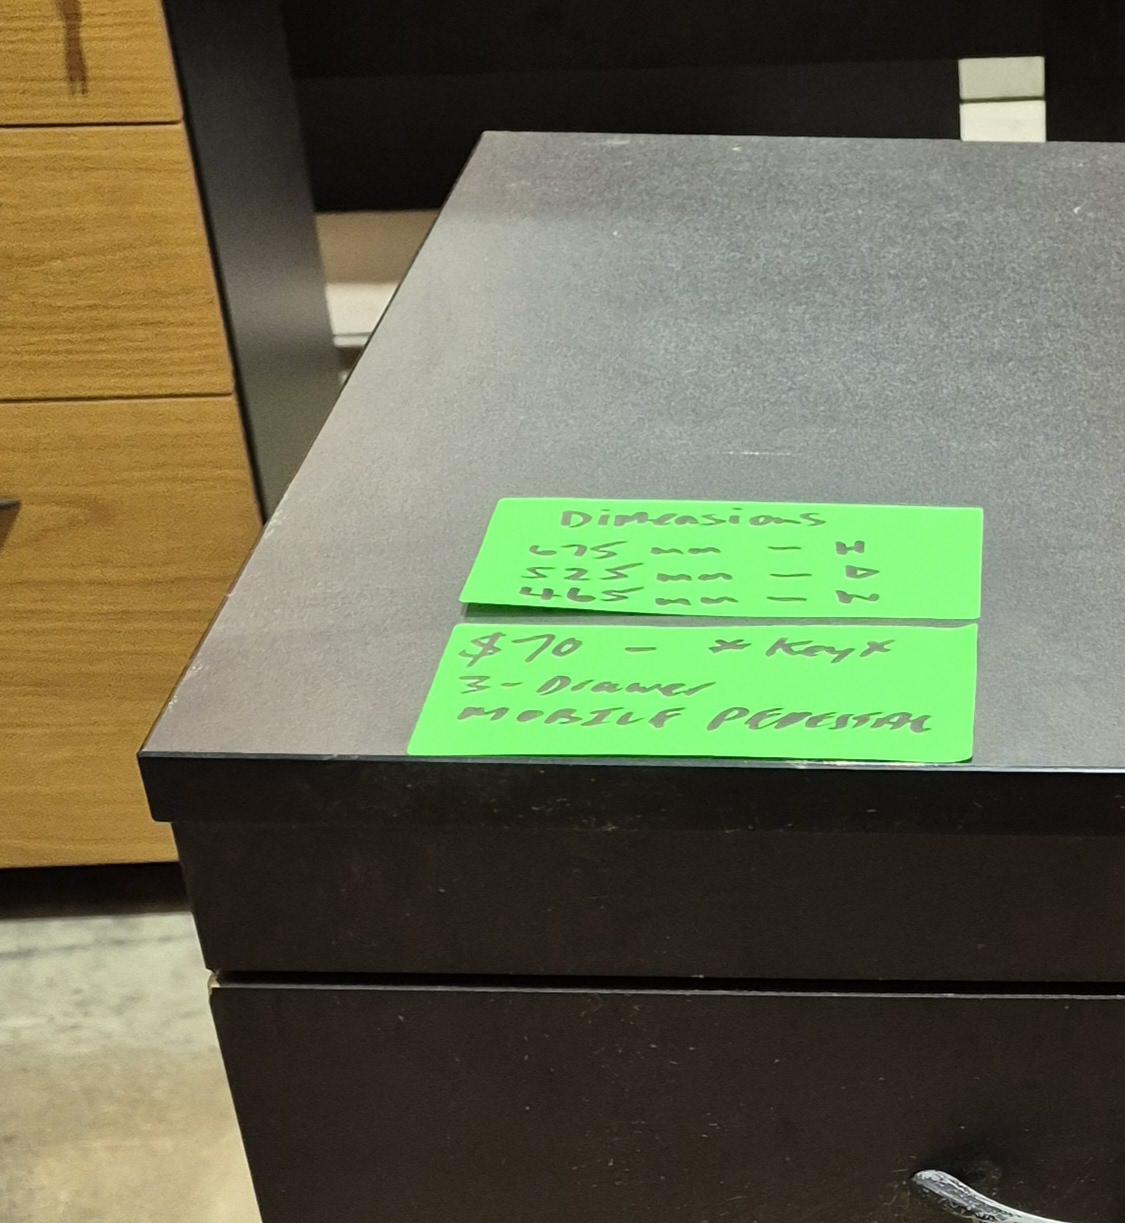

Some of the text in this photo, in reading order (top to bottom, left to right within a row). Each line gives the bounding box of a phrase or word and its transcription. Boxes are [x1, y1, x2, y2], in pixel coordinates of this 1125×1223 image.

[528, 541, 629, 559] 675
[521, 562, 645, 581] 525
[518, 585, 646, 603] 465
[457, 631, 583, 666] $70
